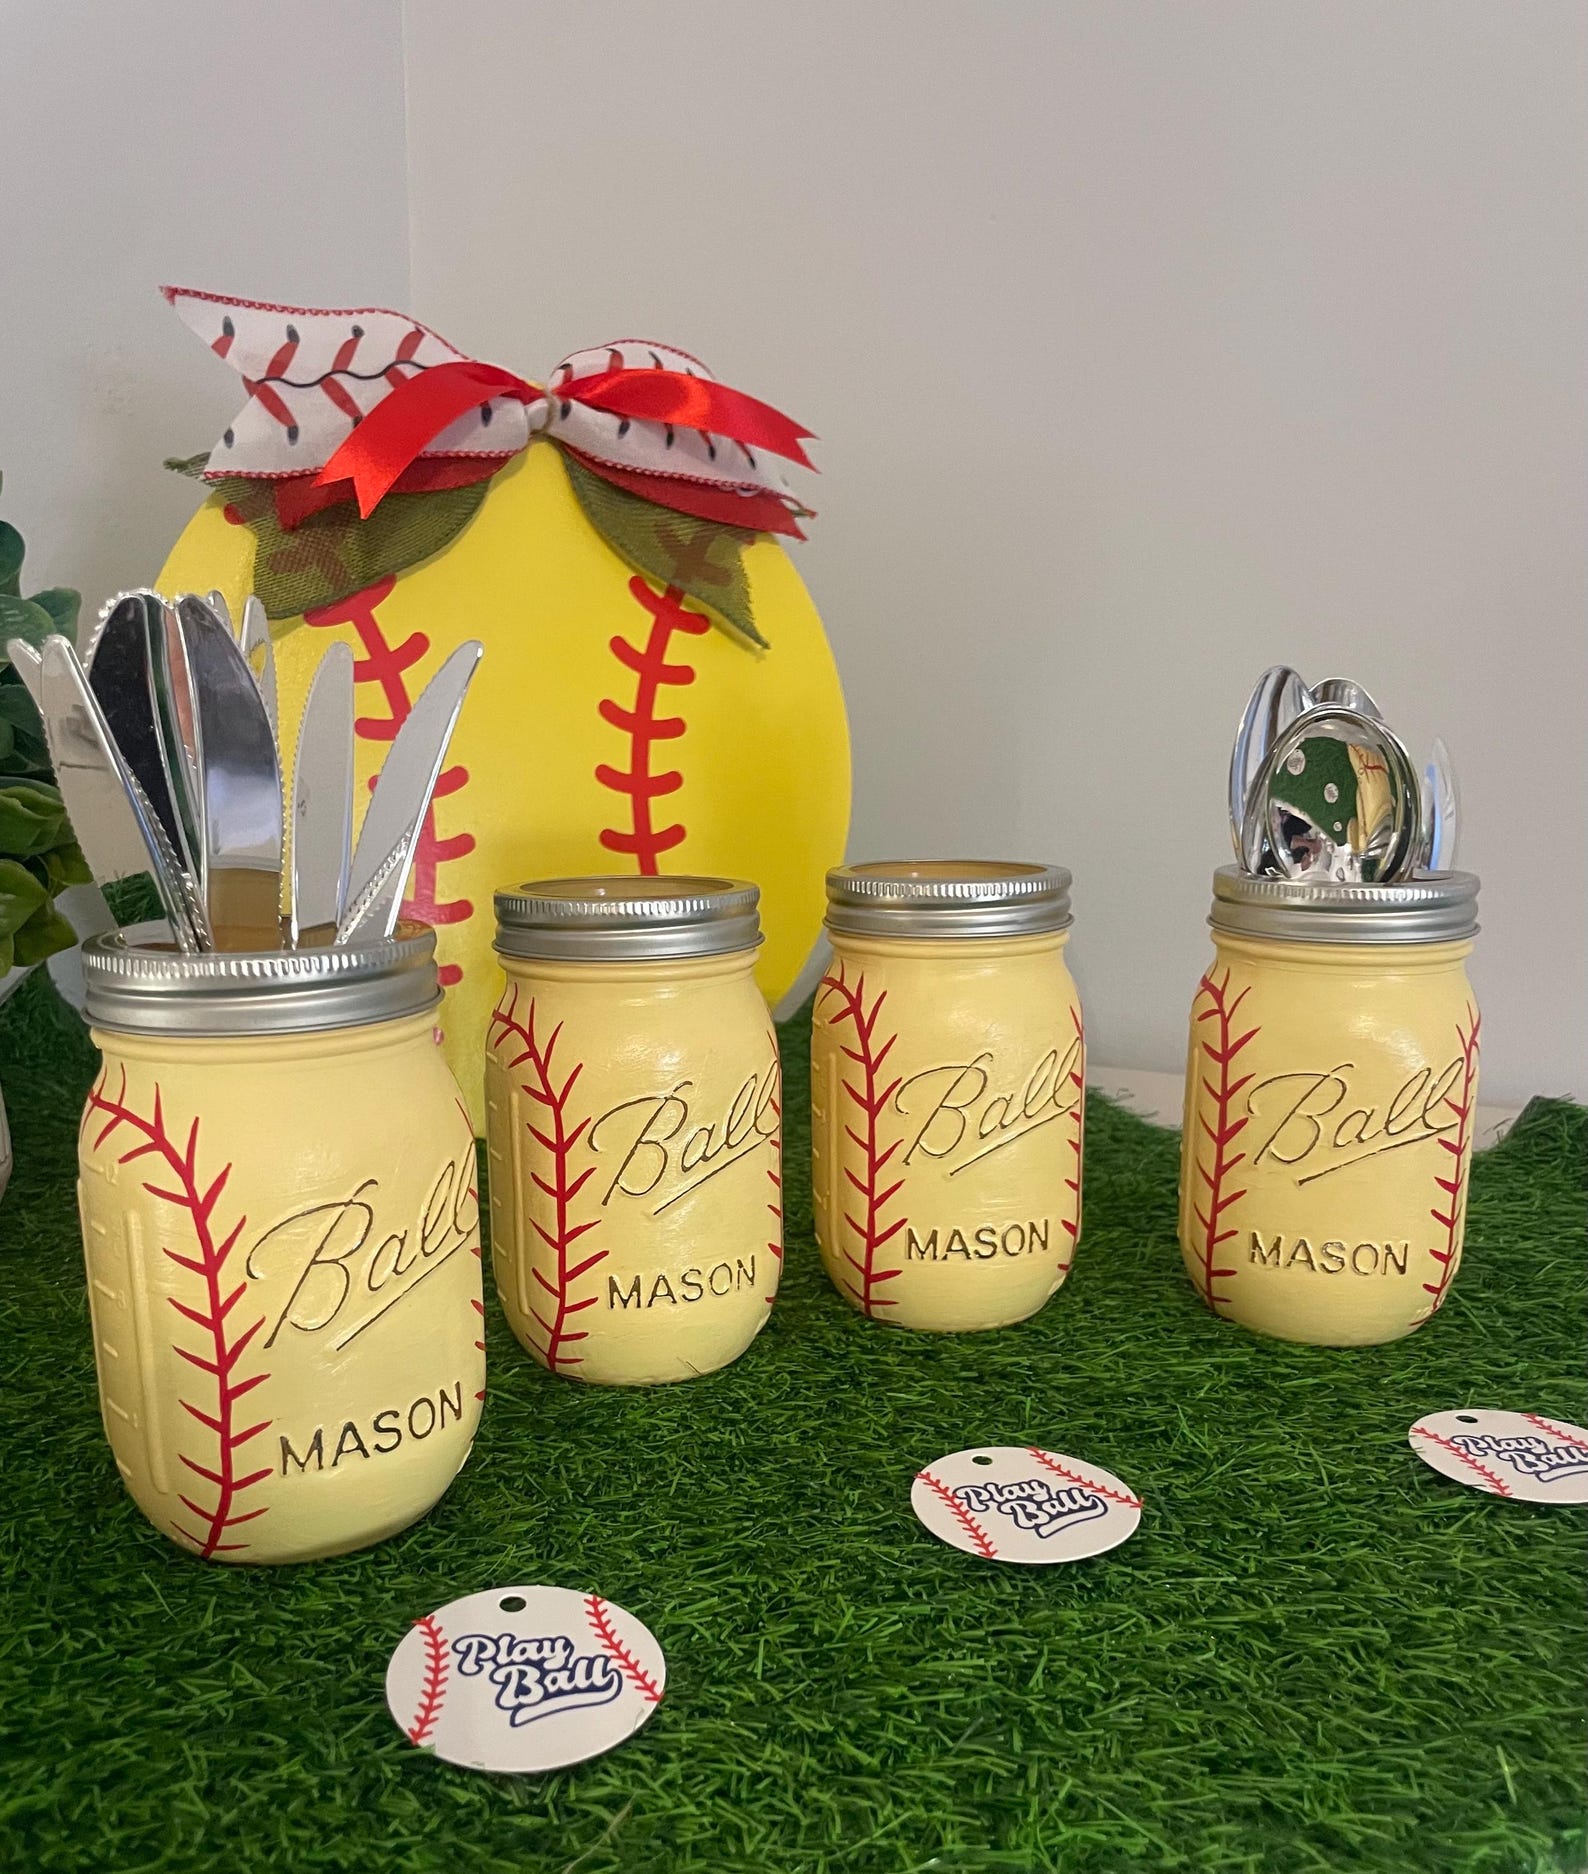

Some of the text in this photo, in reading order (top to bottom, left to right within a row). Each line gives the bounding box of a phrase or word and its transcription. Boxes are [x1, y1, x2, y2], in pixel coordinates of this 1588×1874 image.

[895, 1037, 1079, 1166] Ball
[1247, 1056, 1465, 1166] Ball
[588, 1060, 780, 1206] Ball
[246, 1140, 479, 1349] Ball
[906, 1218, 1049, 1261] MASON
[1250, 1231, 1409, 1276] MASON
[608, 1254, 756, 1310] MASON
[279, 1381, 463, 1475] MASON
[1450, 1435, 1548, 1457] Play
[952, 1479, 1051, 1513] Play
[997, 1487, 1107, 1533] Ball
[451, 1632, 575, 1676] Play
[489, 1654, 621, 1718] Ball
